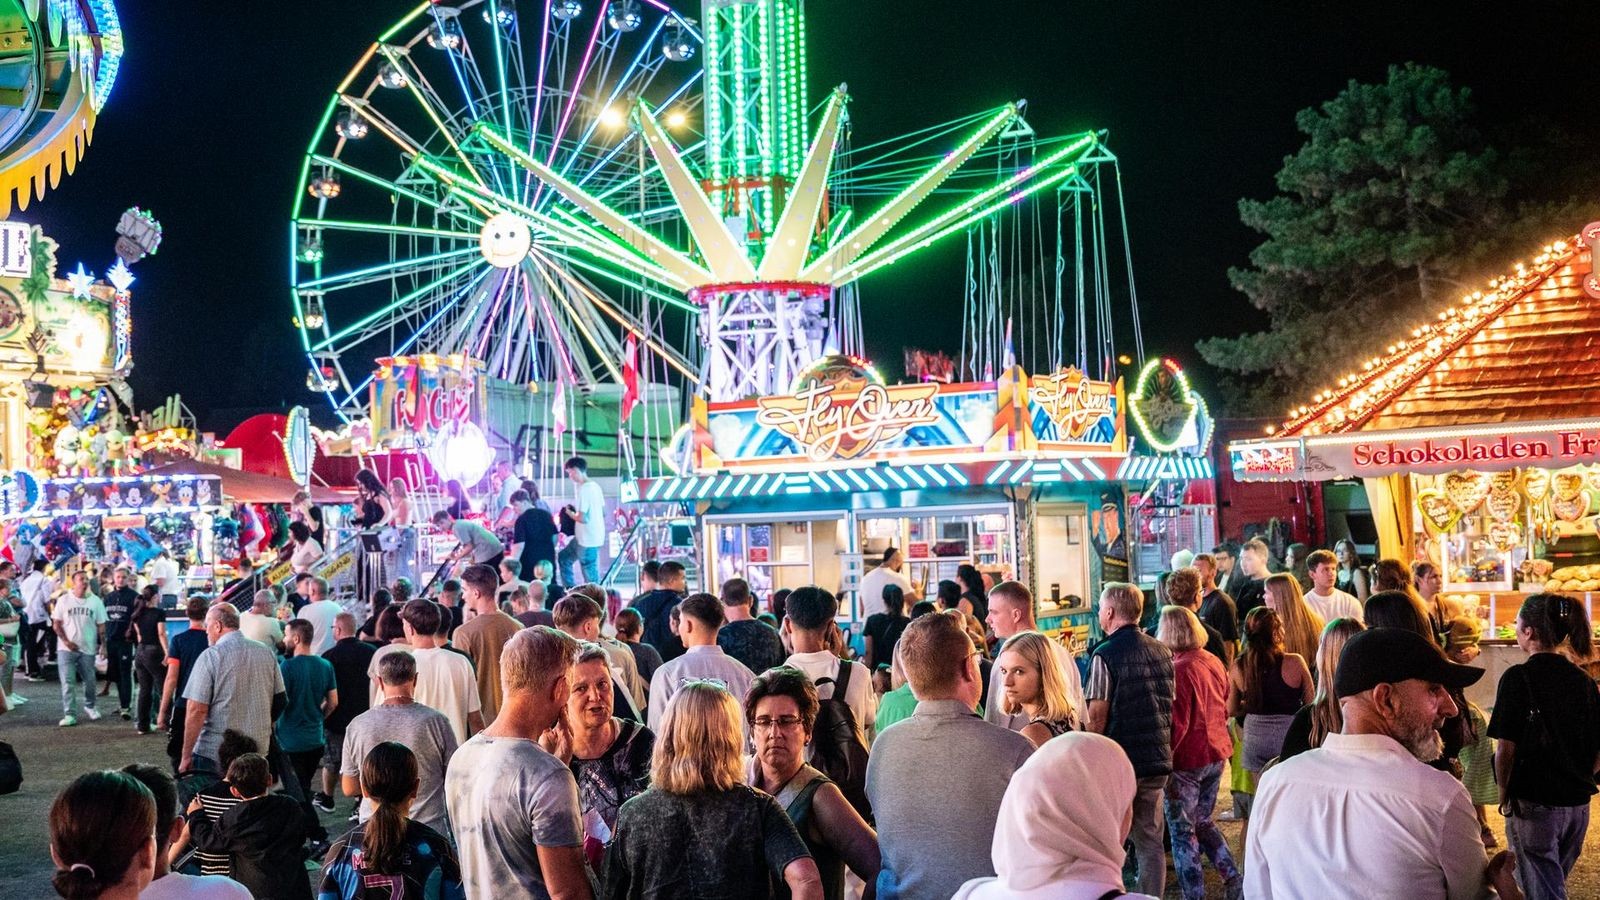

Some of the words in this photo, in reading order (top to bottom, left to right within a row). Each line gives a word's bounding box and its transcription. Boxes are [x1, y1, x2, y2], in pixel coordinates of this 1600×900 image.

[757, 379, 844, 461] Fly
[847, 384, 940, 440] Over
[1354, 437, 1551, 467] Schokoladen
[1559, 431, 1600, 456] Fr
